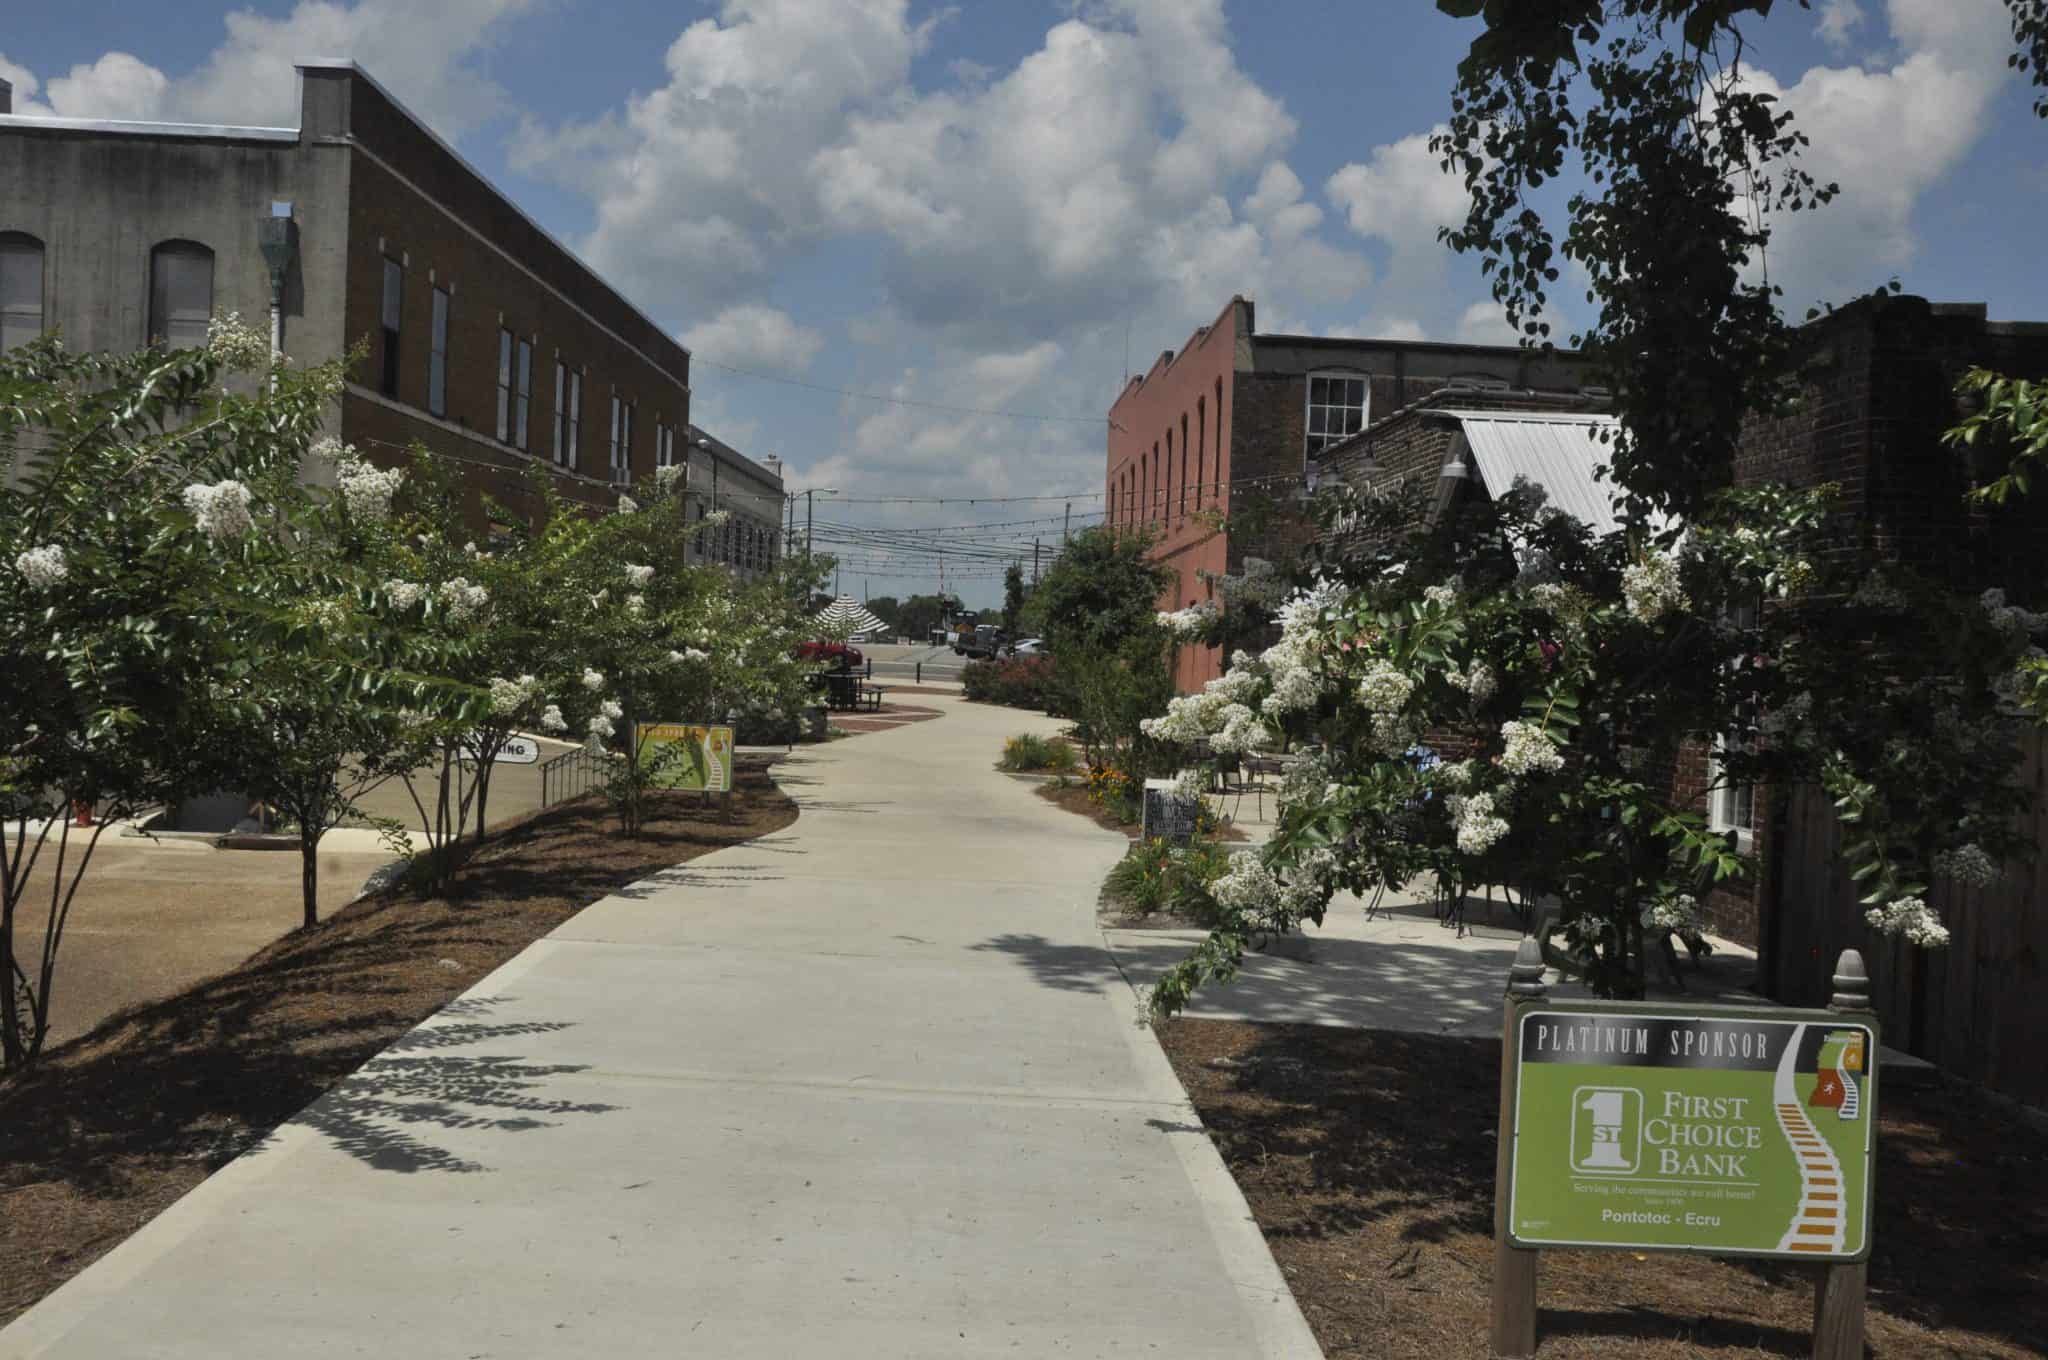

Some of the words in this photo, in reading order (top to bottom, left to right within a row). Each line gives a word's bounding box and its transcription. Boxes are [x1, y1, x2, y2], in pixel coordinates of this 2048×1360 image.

[1537, 1024, 1648, 1054] PLATINUM
[1670, 1030, 1767, 1059] SPONSOR
[1662, 1091, 1749, 1120] FIRST
[1593, 1126, 1622, 1142] ST
[1644, 1119, 1761, 1149] CHOICE
[1658, 1148, 1748, 1177] BANK
[1574, 1183, 1609, 1196] Serving
[1612, 1184, 1626, 1195] the
[1601, 1209, 1671, 1225] Pontotoc
[1685, 1212, 1721, 1227] Ecru
